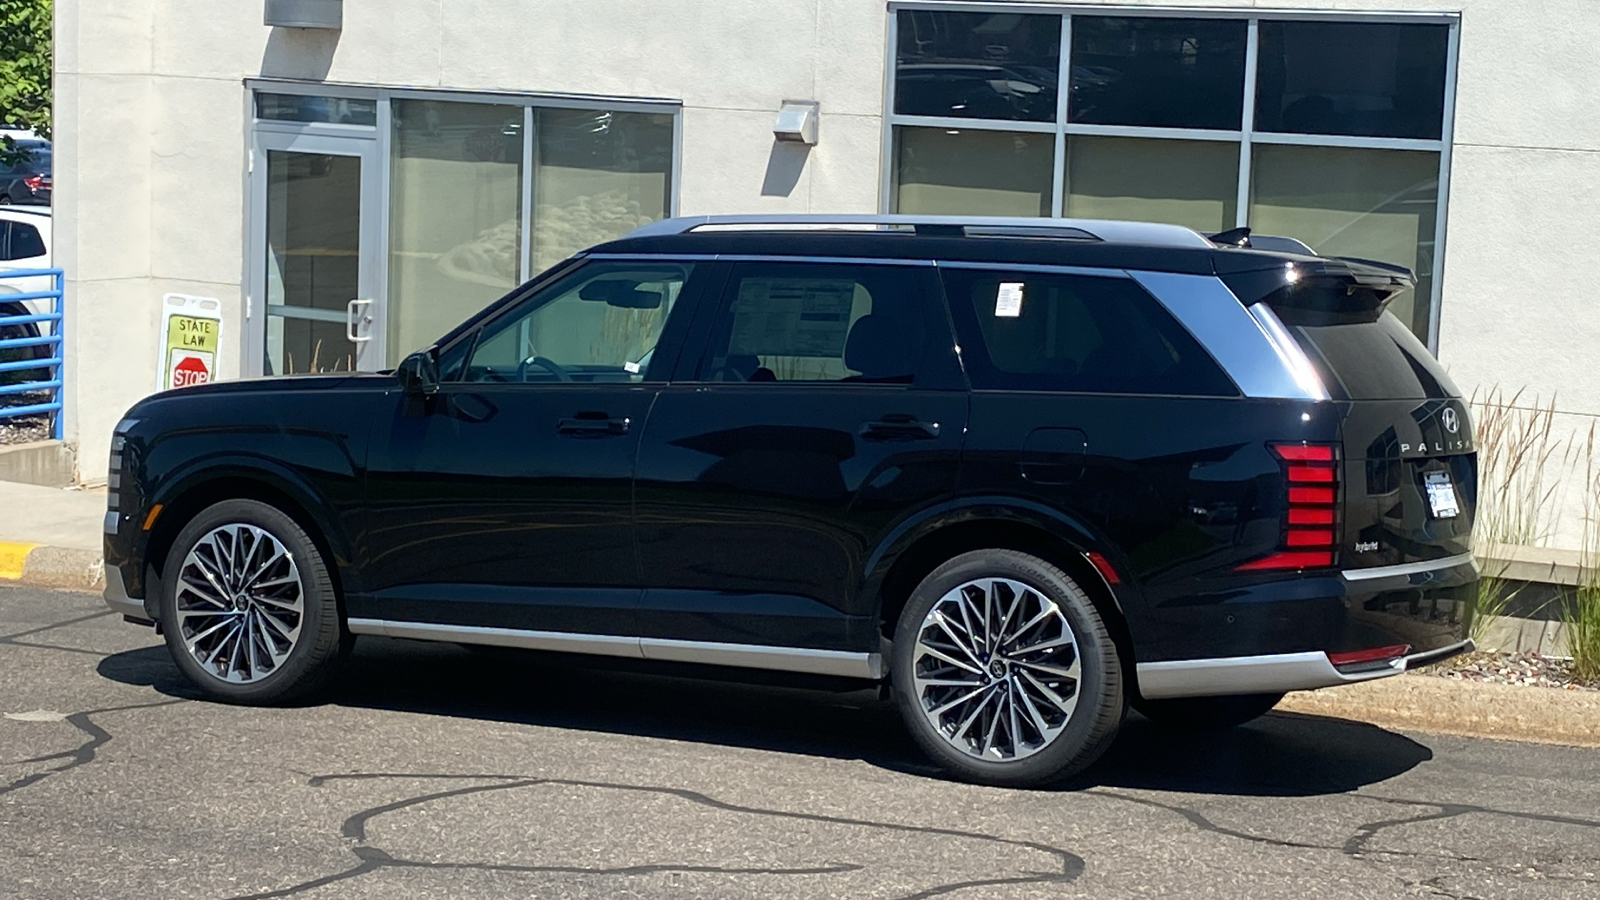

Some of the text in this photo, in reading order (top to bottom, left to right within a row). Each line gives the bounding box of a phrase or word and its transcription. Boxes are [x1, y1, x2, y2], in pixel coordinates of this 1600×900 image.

[179, 319, 211, 334] STATE
[183, 334, 206, 347] LAW
[174, 369, 208, 386] STOP
